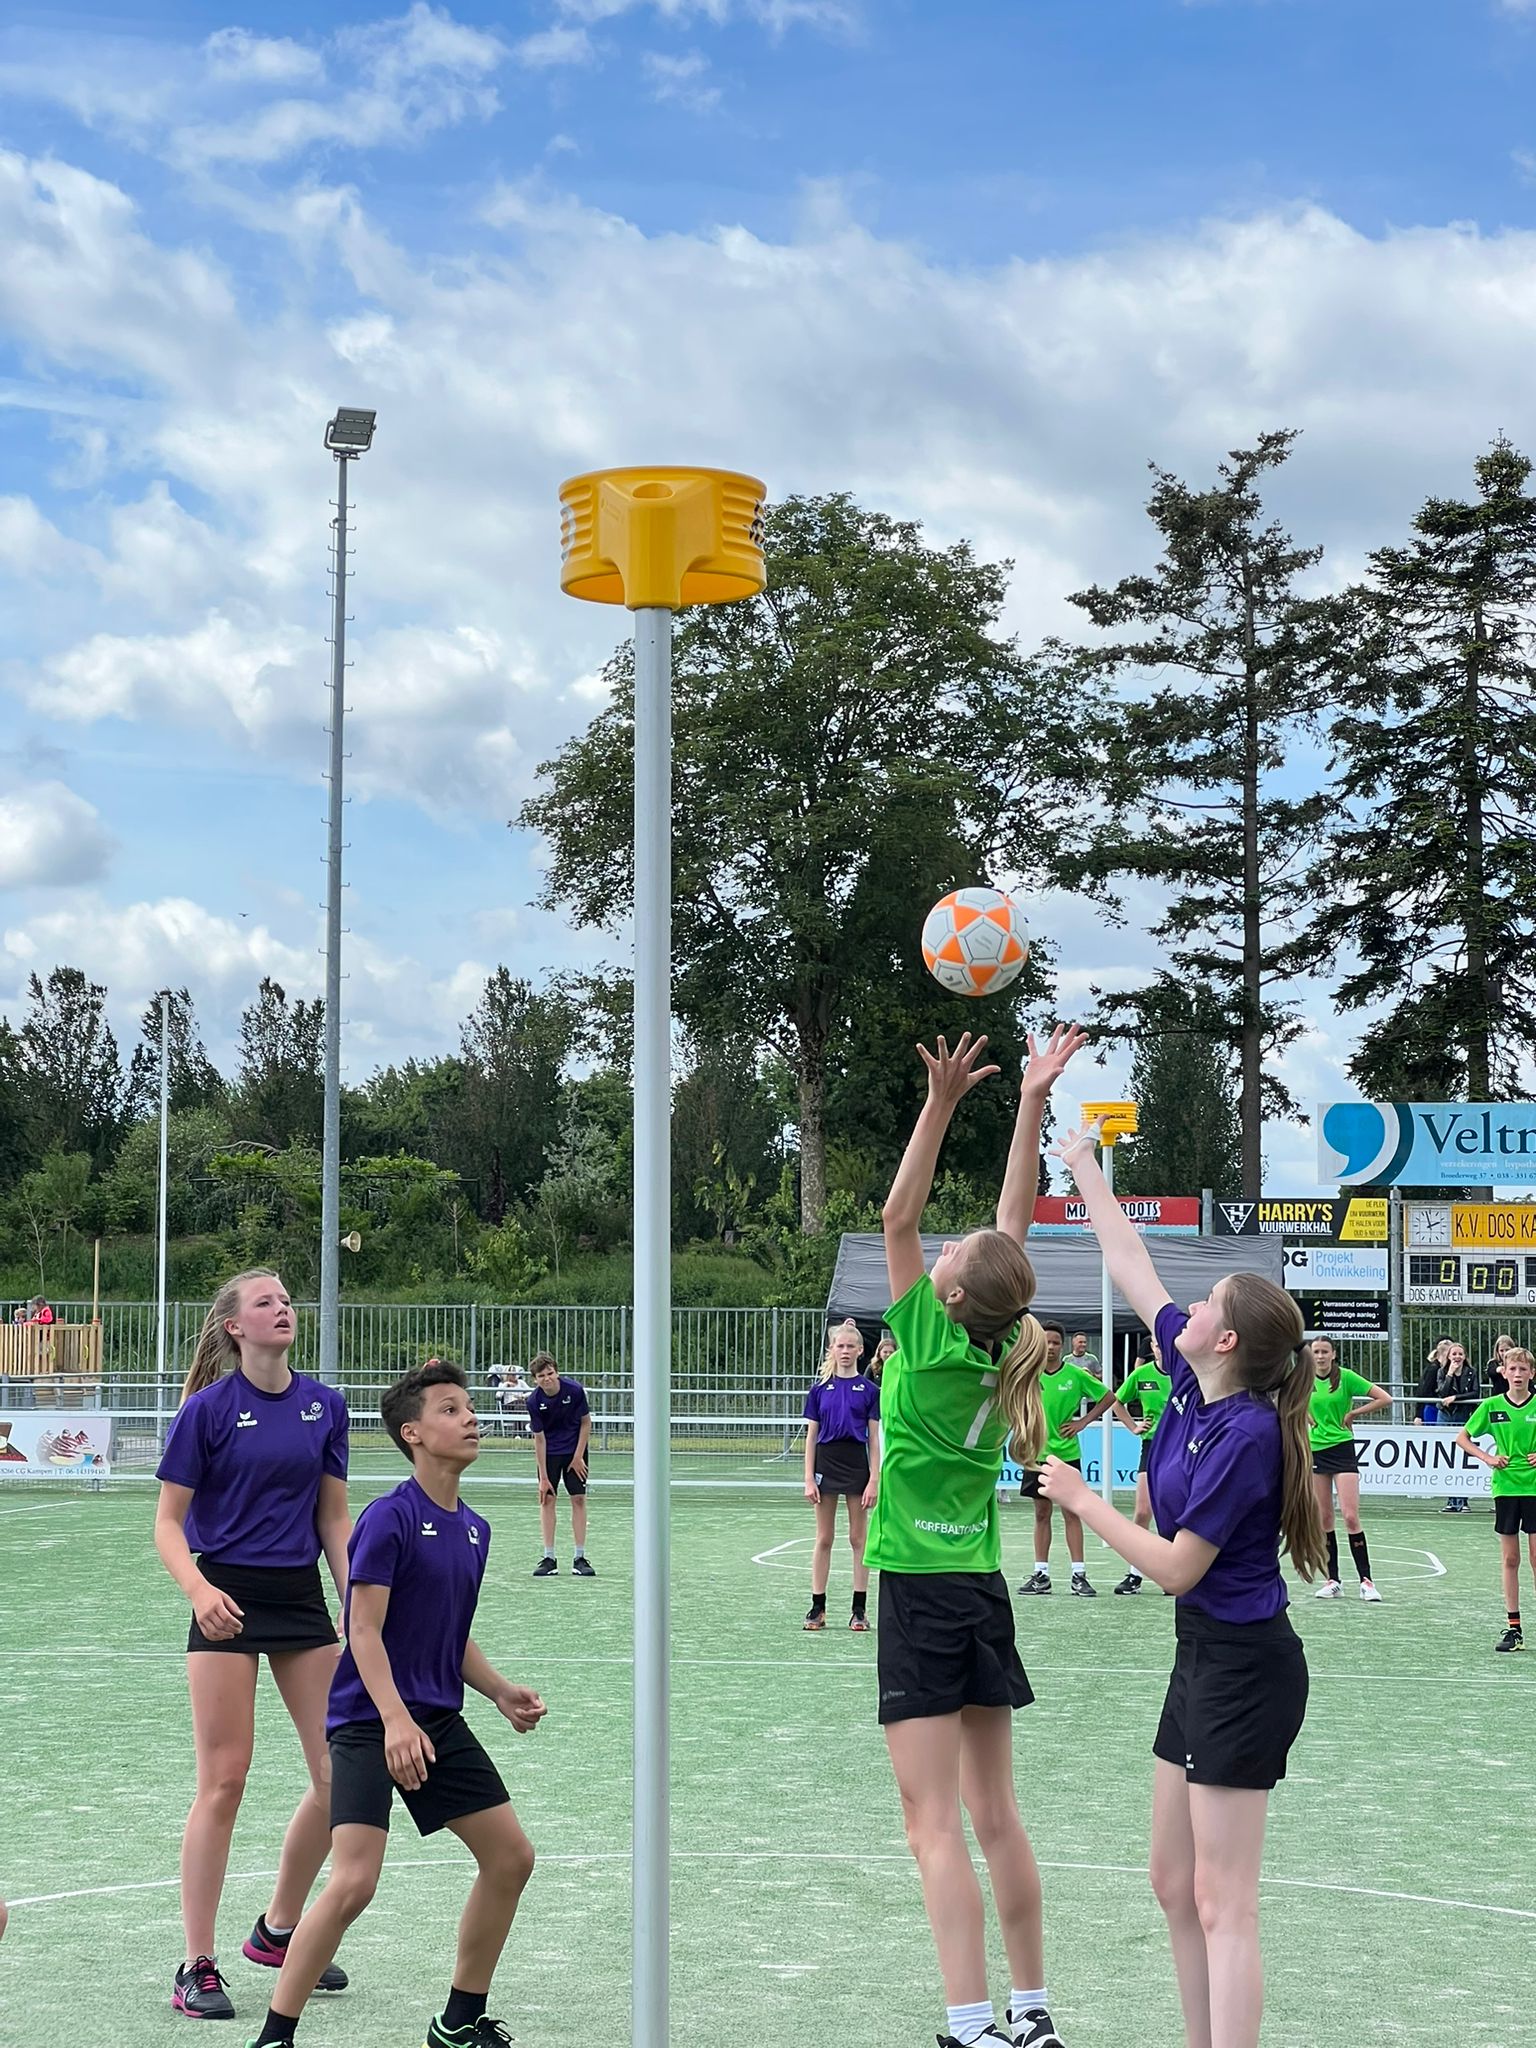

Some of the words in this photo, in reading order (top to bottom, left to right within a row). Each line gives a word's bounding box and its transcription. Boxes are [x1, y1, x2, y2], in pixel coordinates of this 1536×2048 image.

[1258, 1203, 1333, 1222] HARRY'S
[1259, 1222, 1333, 1233] VUURWERKHAL
[1455, 1213, 1483, 1238] K.V.
[1488, 1213, 1515, 1239] DOS
[1316, 1251, 1354, 1265] Projekt
[1316, 1265, 1386, 1280] Ontwikkeling
[1410, 1288, 1426, 1301] DOS
[1429, 1288, 1463, 1302] KAMPEN
[1322, 1311, 1355, 1319] Vakkundige
[1358, 1471, 1438, 1486] uurzame
[1444, 1473, 1493, 1492] energ
